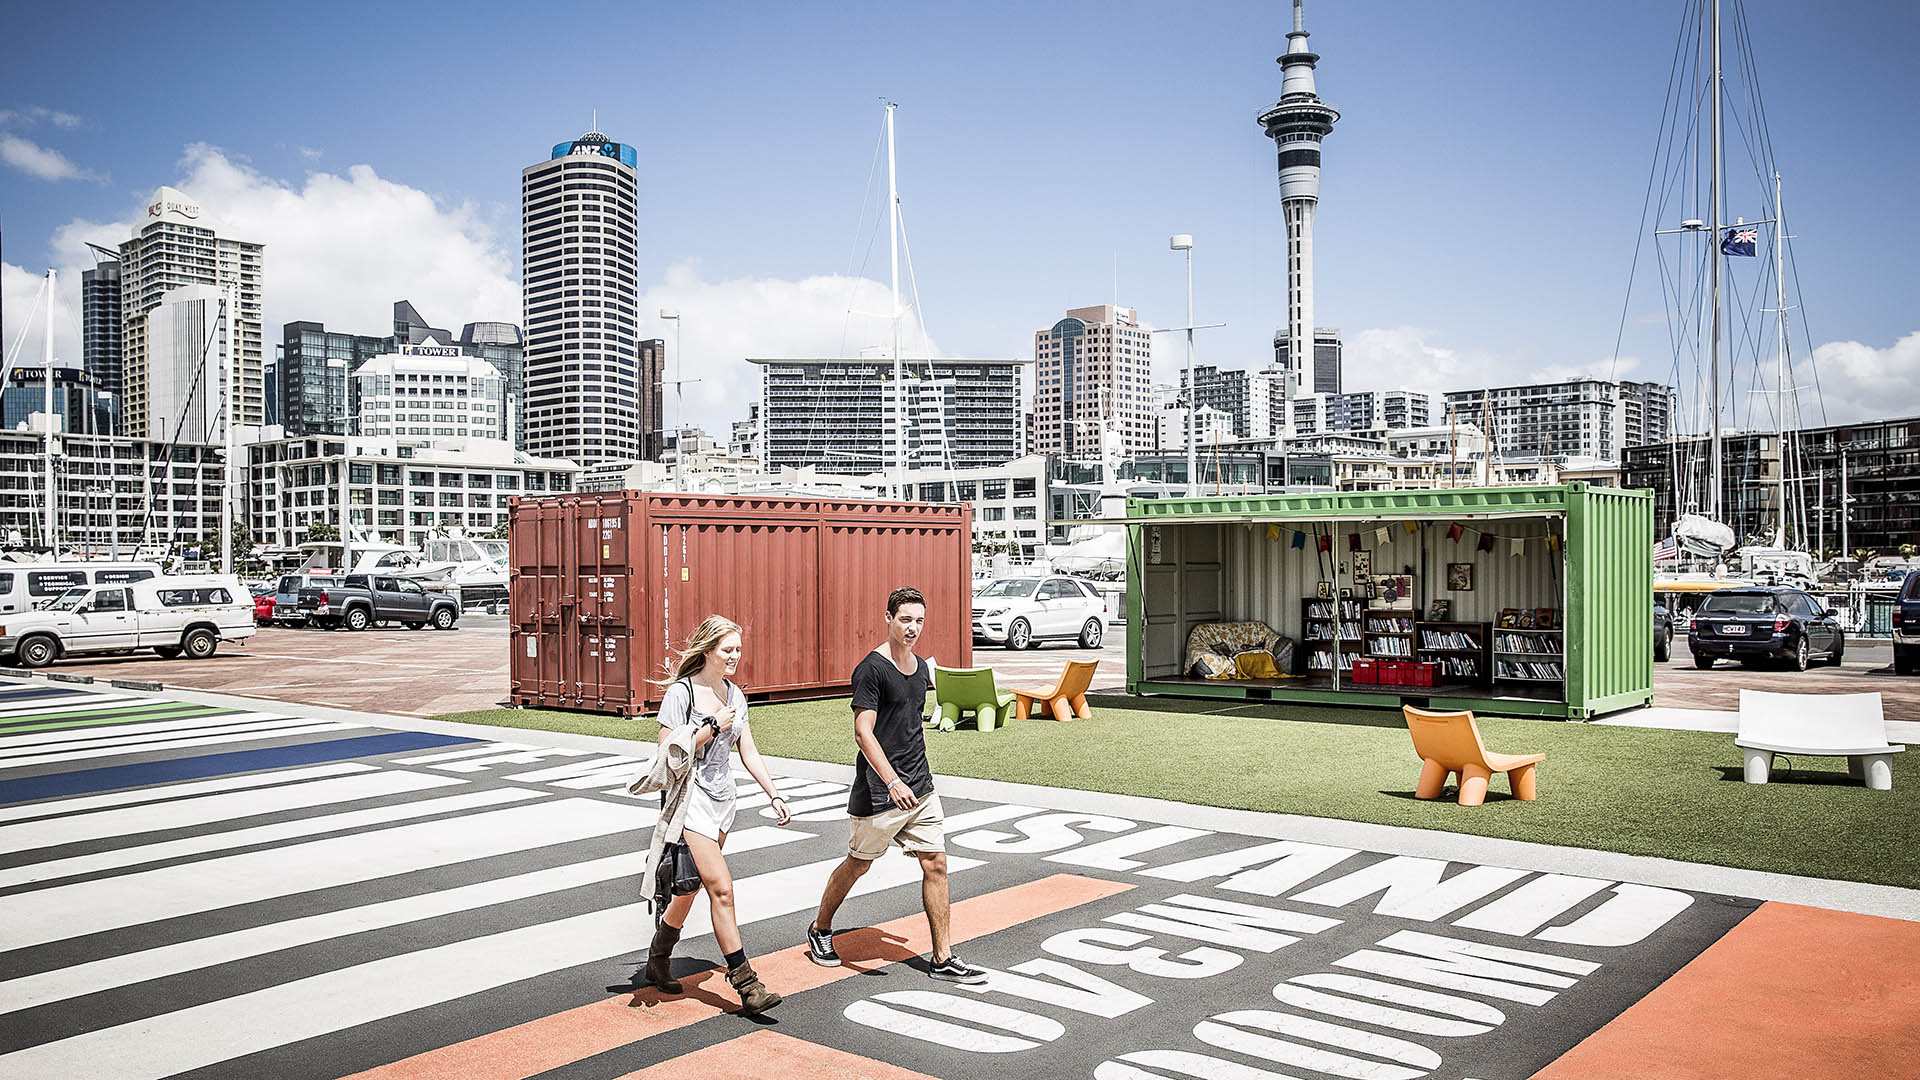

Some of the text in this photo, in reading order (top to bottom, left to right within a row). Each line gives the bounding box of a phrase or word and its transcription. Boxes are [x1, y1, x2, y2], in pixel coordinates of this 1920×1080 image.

[572, 145, 601, 156] ANZ
[418, 347, 456, 356] TOWER
[24, 370, 62, 378] TOWR
[944, 803, 1696, 947] ISLAND
